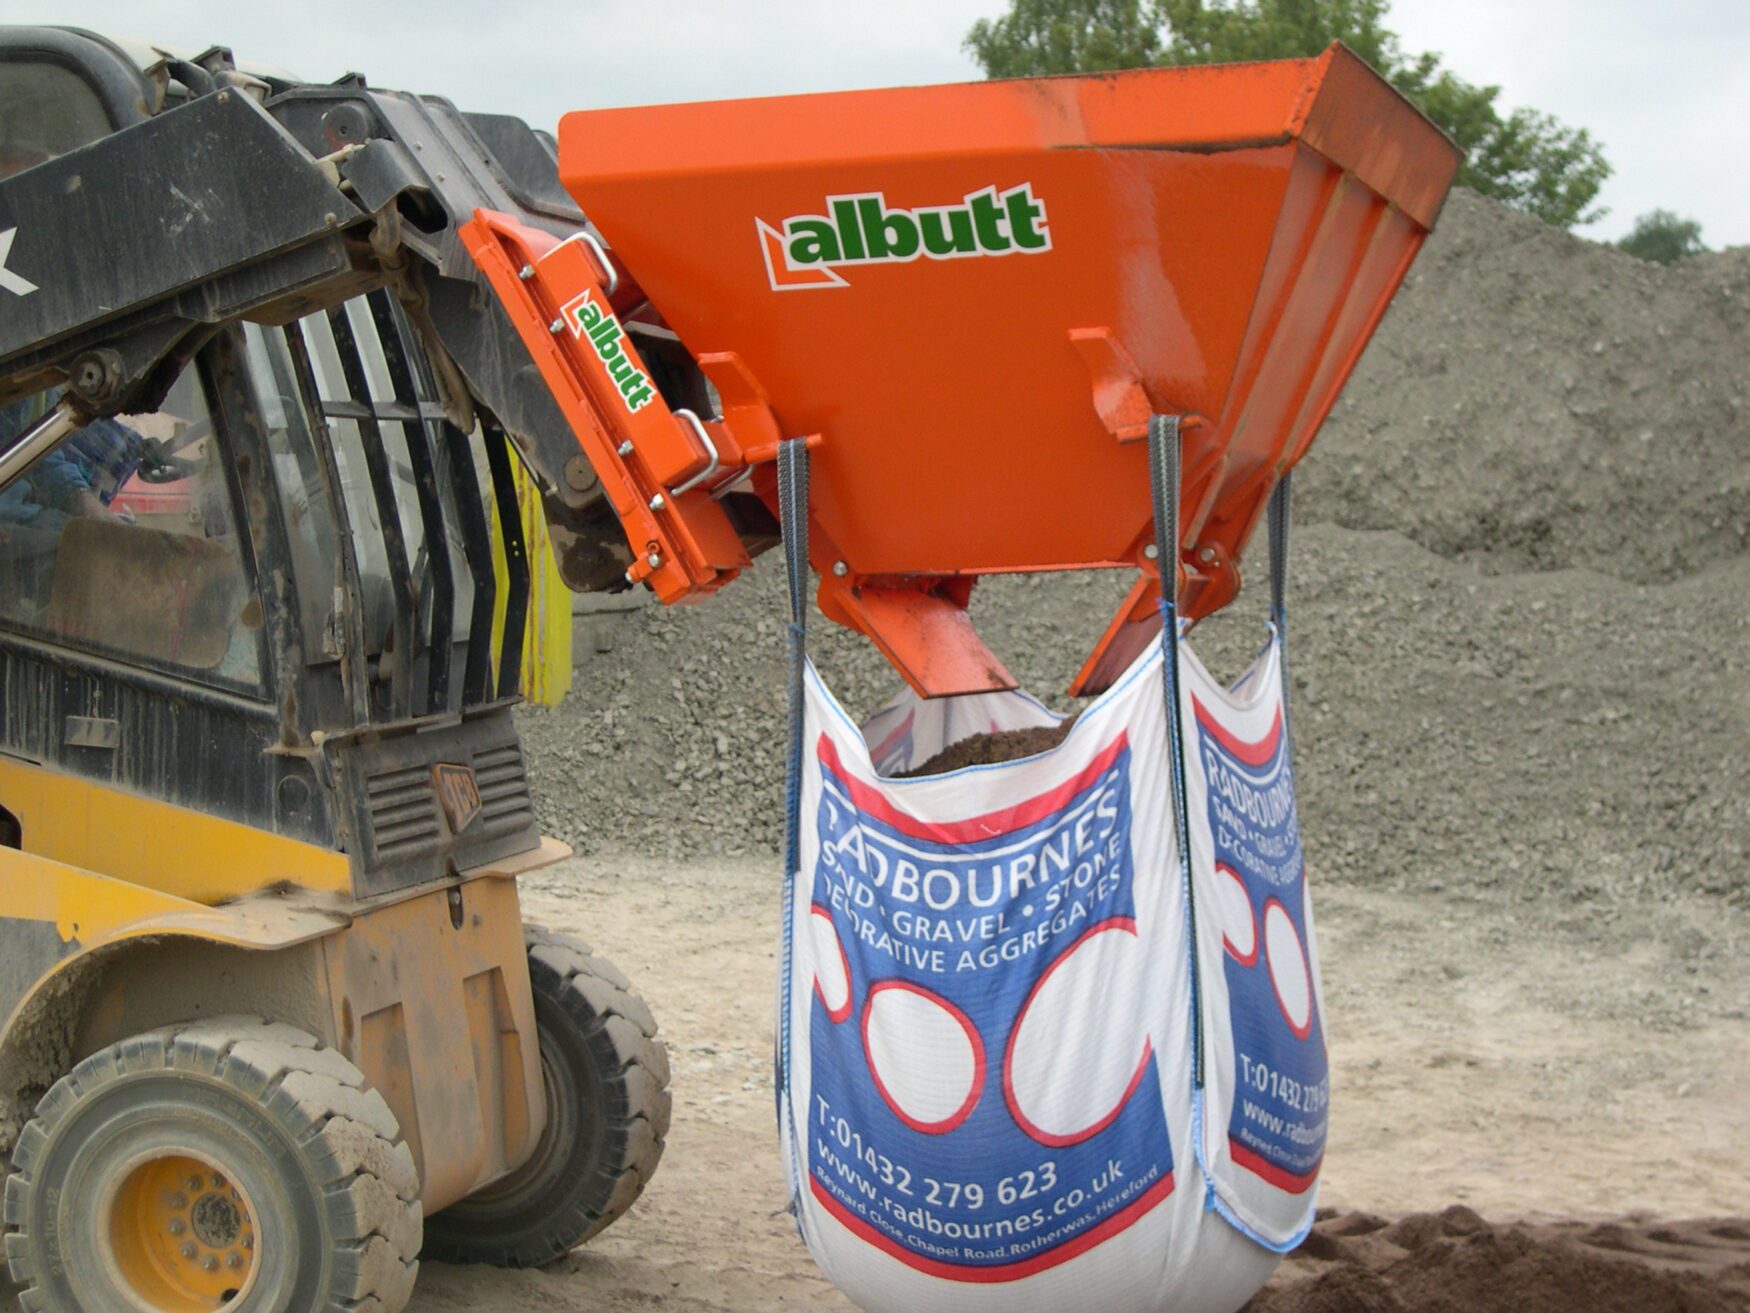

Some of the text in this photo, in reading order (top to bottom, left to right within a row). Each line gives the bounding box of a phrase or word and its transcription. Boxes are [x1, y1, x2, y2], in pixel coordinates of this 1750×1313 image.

[785, 184, 1052, 263] albutt
[574, 301, 656, 412] albutt
[893, 911, 1010, 942] GRAVEL
[1045, 832, 1120, 911] STONE
[956, 864, 1120, 972] AGGREGATES
[816, 1093, 1057, 1210] T:01432 279 623
[818, 1138, 1124, 1239] www.radbournes.co.uk
